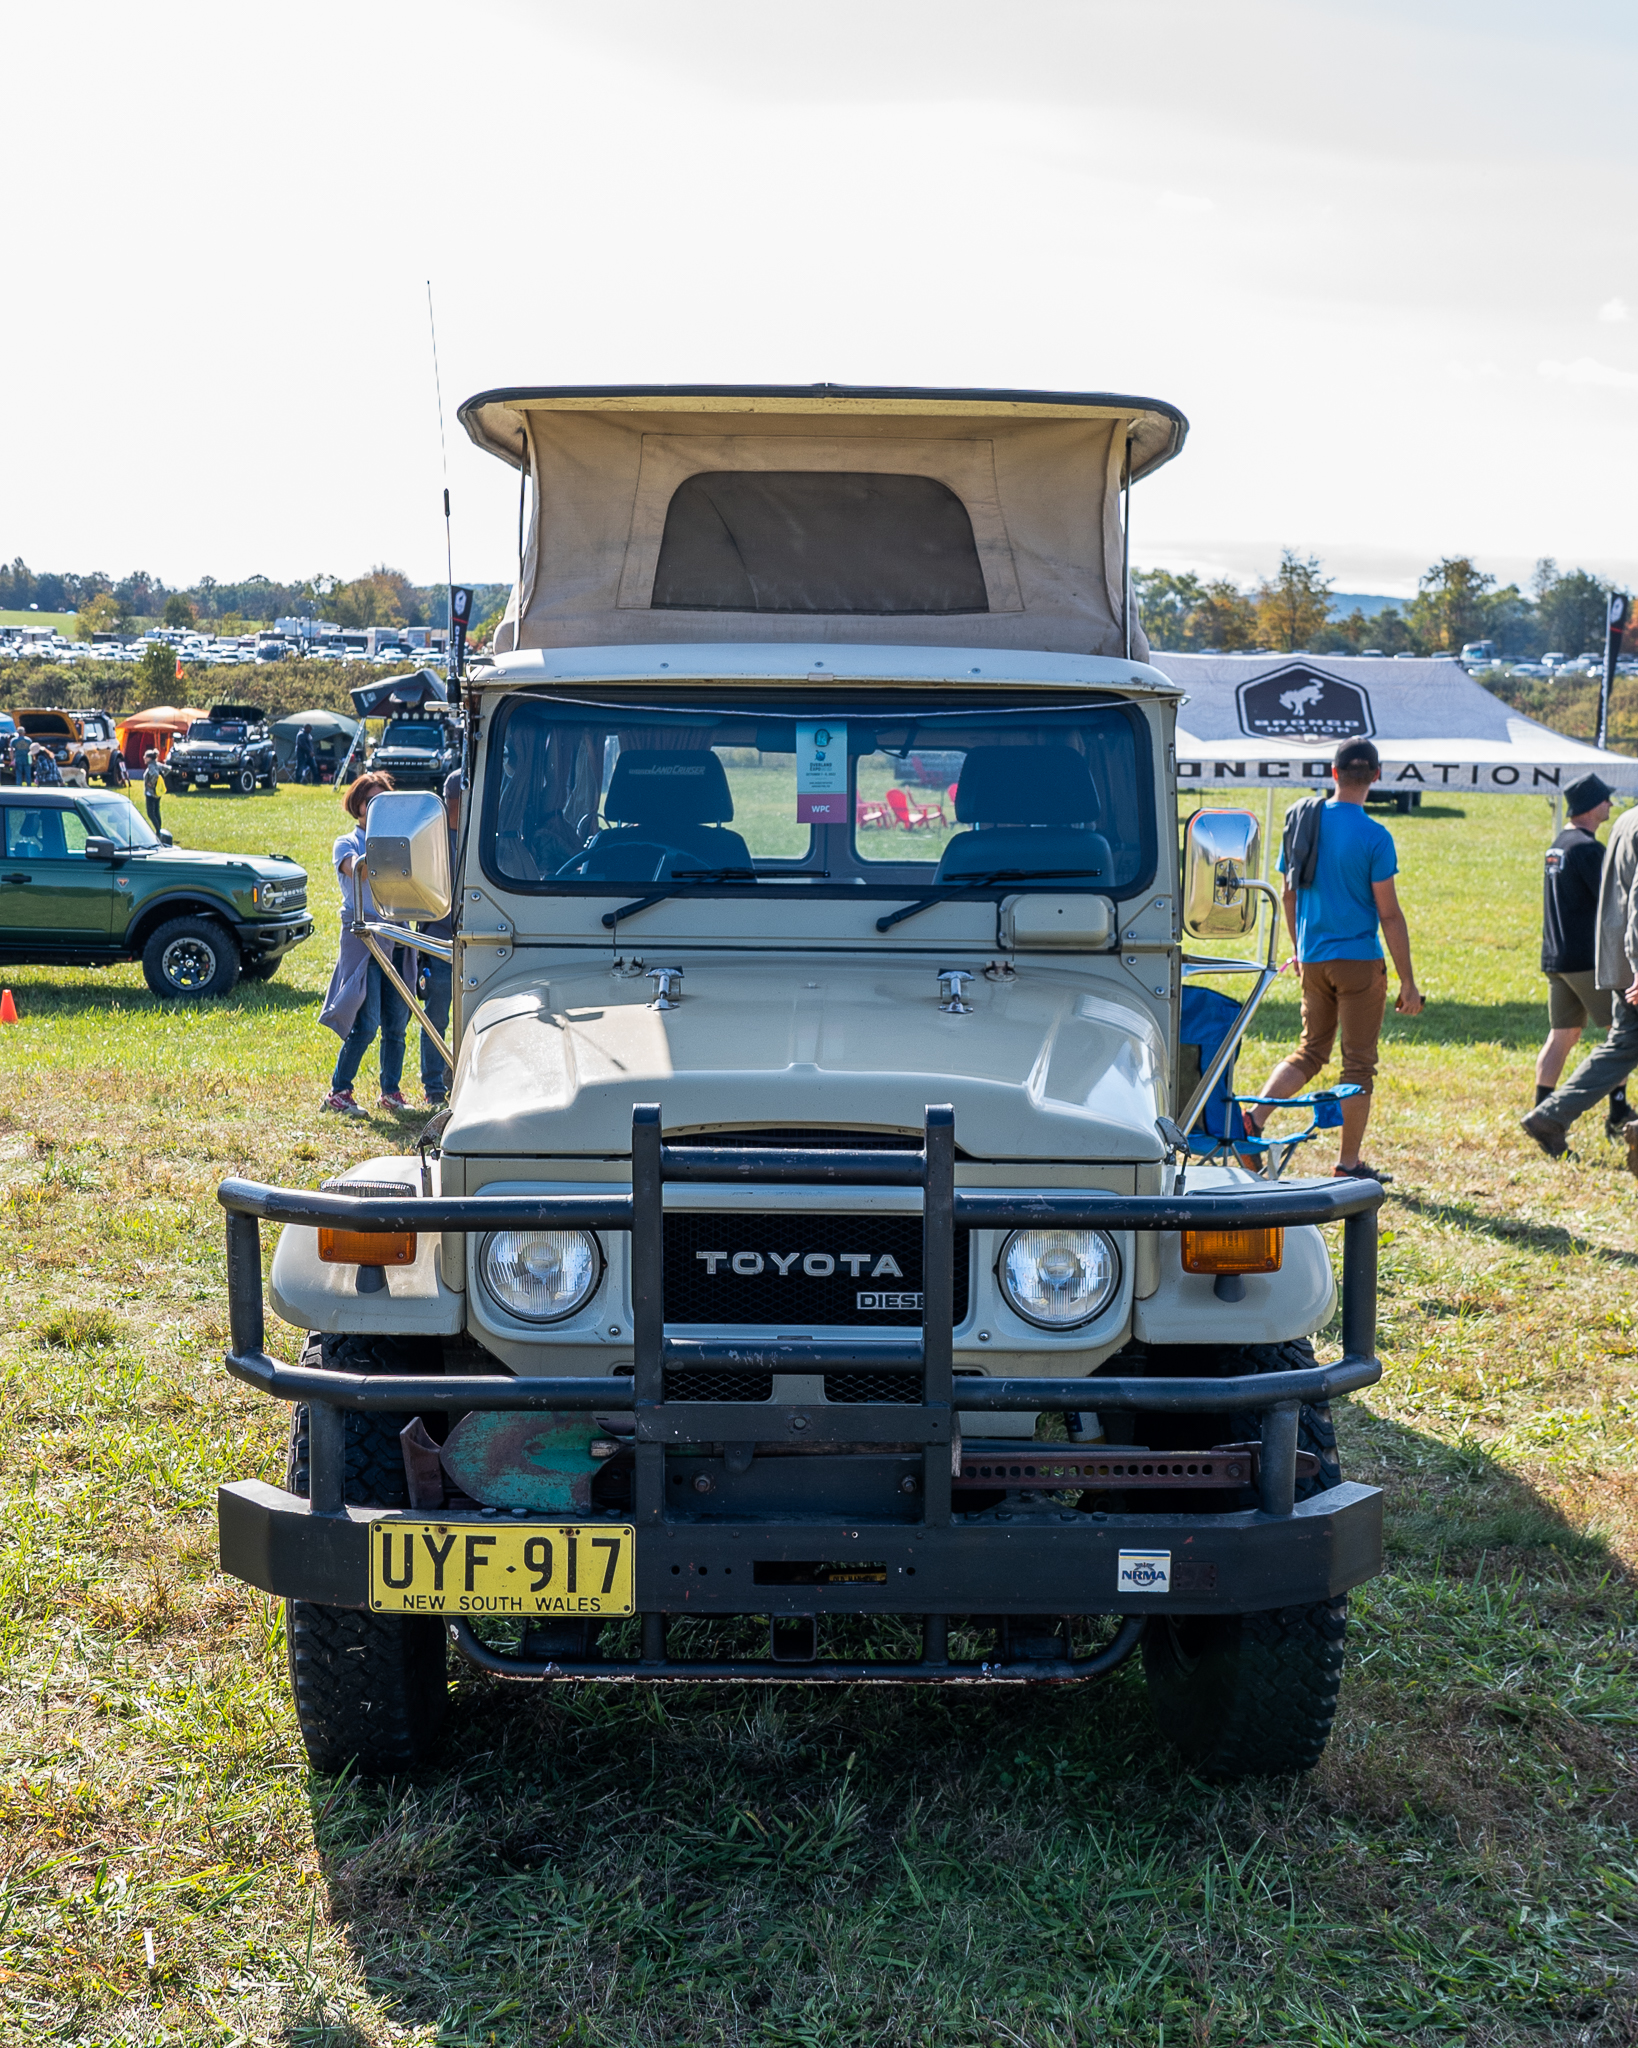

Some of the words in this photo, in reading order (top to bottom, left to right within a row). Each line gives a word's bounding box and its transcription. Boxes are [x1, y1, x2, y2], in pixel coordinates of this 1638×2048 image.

[1266, 725, 1350, 733] NATION
[1177, 762, 1333, 778] ONCO
[1378, 763, 1560, 787] ATION
[811, 805, 830, 813] WPC
[696, 1251, 904, 1277] TOYOTA
[1121, 1570, 1167, 1581] NRMA
[403, 1595, 446, 1609] NEW
[459, 1596, 522, 1611] SOUTH
[535, 1597, 601, 1612] WALES
